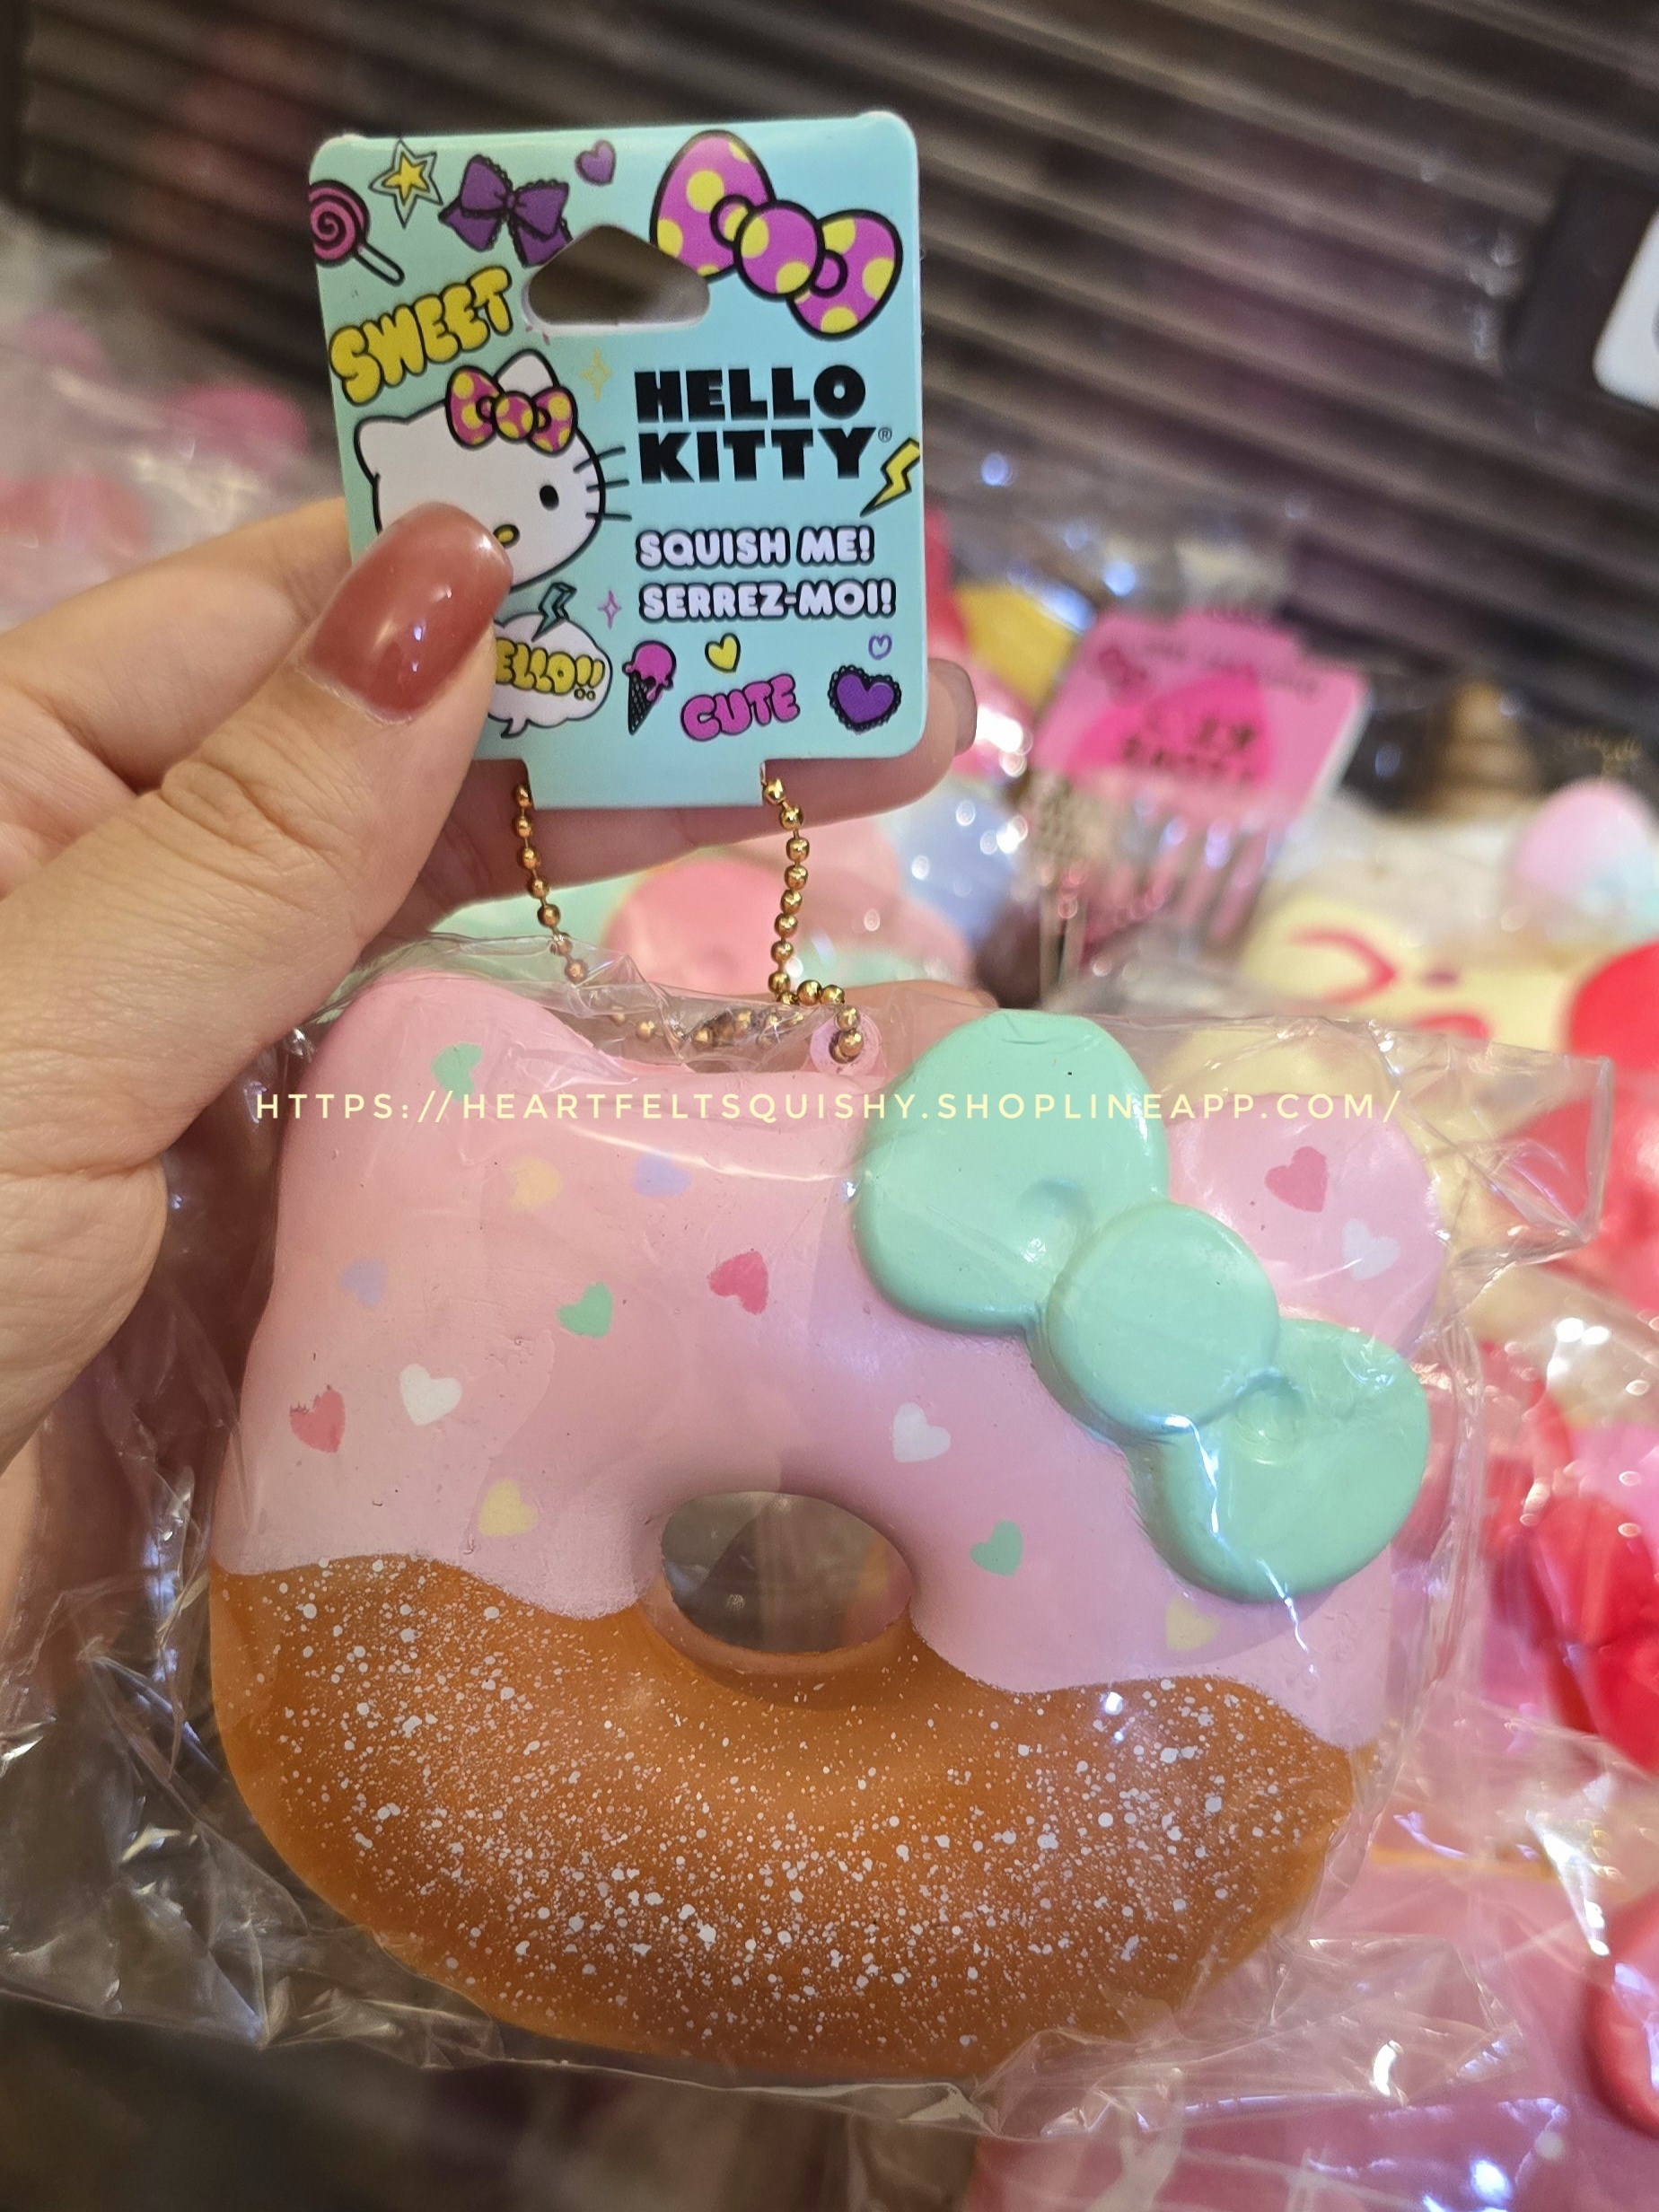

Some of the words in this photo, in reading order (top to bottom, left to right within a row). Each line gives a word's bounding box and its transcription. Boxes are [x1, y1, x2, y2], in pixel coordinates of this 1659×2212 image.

[329, 267, 514, 406] SWEET
[634, 364, 866, 423] HELLO
[636, 526, 790, 570] SQUISH
[796, 524, 875, 566] ME!
[638, 577, 897, 621] SERREZ-MOI!
[495, 636, 606, 701] ELLO!!
[680, 673, 800, 742] CUTE
